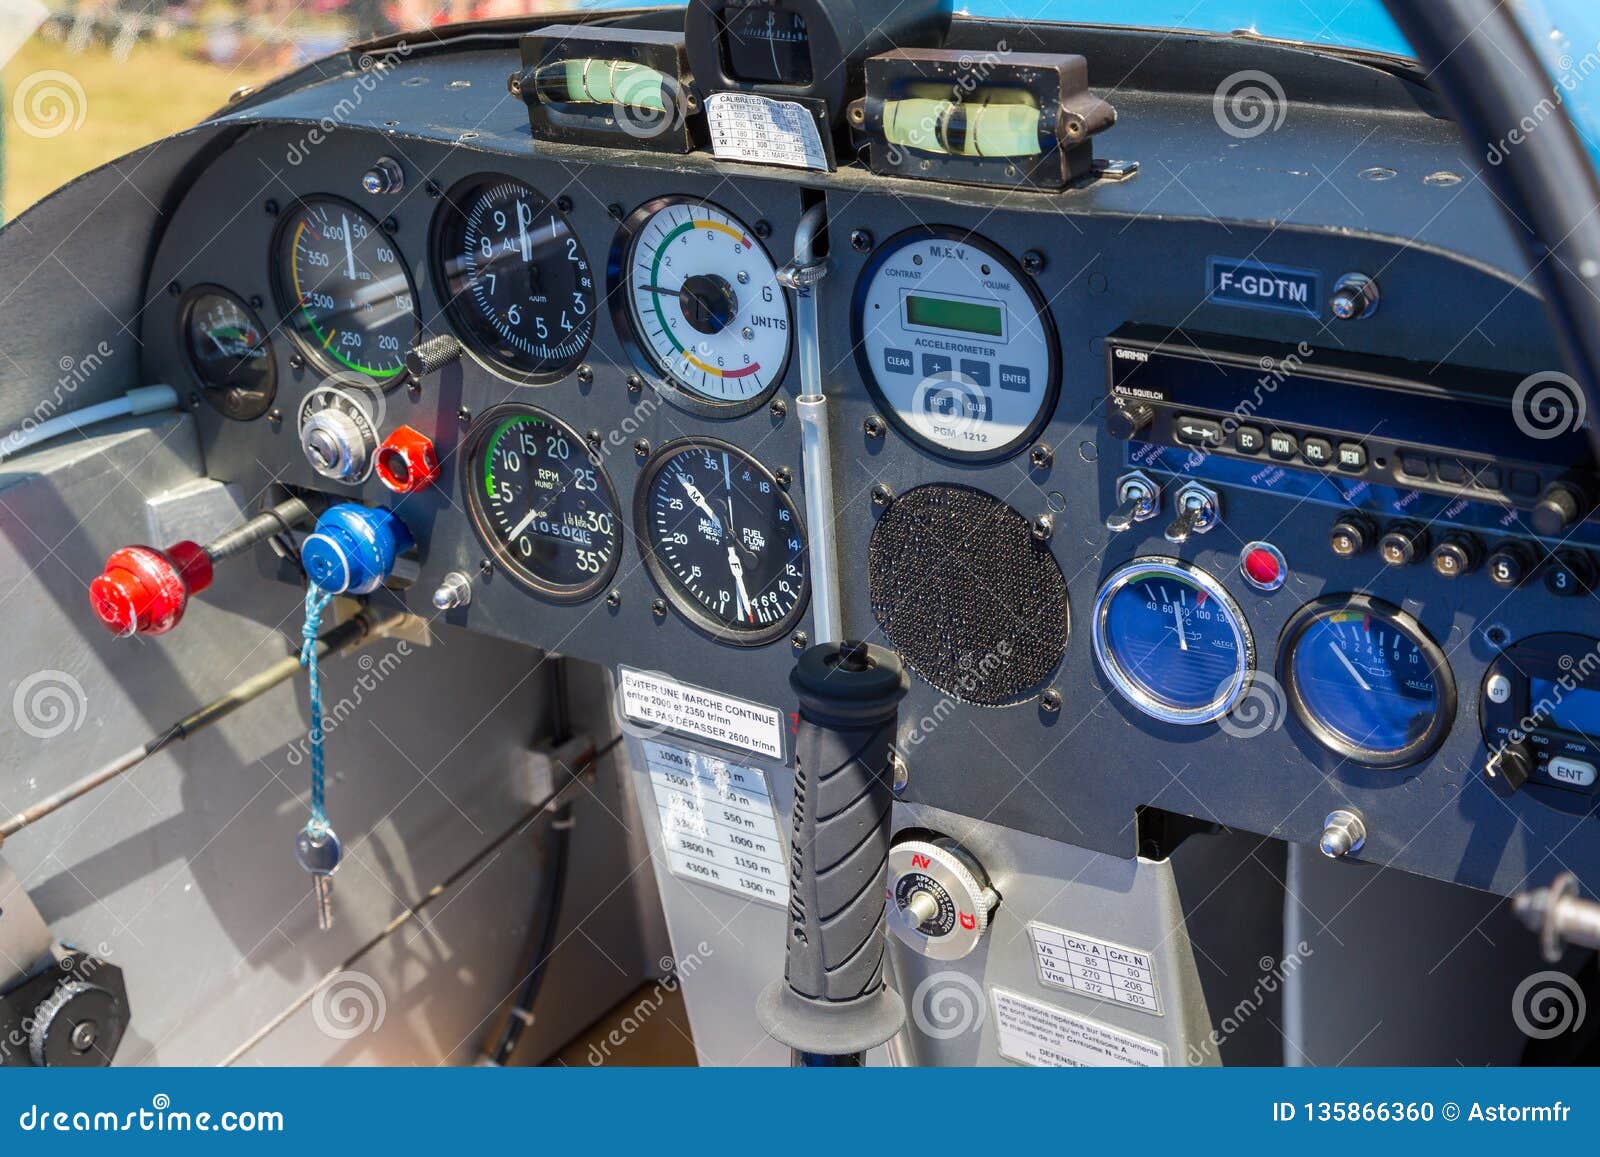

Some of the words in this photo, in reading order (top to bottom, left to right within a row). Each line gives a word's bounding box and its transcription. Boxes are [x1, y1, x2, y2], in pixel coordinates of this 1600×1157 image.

[494, 210, 506, 232] 9
[323, 227, 344, 240] 400
[352, 225, 367, 238] 50
[707, 231, 714, 241] 6
[481, 236, 492, 258] 8
[681, 236, 688, 245] 4
[377, 247, 394, 263] 100
[566, 237, 579, 261] 2
[734, 243, 741, 254] 8
[308, 251, 329, 266] 350
[664, 256, 672, 267] 2
[884, 267, 922, 280] CONTRAST
[485, 273, 496, 295] 7
[982, 279, 1011, 291] VOLUME
[1220, 272, 1308, 302] F-GDTM
[312, 292, 334, 309] 300
[763, 285, 773, 303] G
[573, 292, 586, 315] 3
[508, 304, 521, 325] 6
[561, 310, 574, 332] 4
[751, 314, 787, 330] UNITS
[536, 317, 548, 339] 5
[670, 317, 677, 328] 2
[341, 331, 361, 347] 250
[379, 335, 399, 350] 200
[914, 338, 996, 357] ACCELEROMETER
[717, 356, 725, 367] 6
[743, 354, 750, 364] 8
[1115, 349, 1149, 362] GARMIN
[887, 356, 911, 371] CLEAR
[1002, 373, 1027, 389] ENTER
[1133, 388, 1163, 400] SQUELCH
[519, 433, 537, 456] 15
[963, 431, 988, 446] 1212
[1241, 433, 1253, 449] EC
[546, 435, 569, 460] 20
[1271, 438, 1290, 455] MON
[1306, 444, 1324, 461] RCL
[501, 449, 520, 473] 10
[1340, 449, 1360, 466] MEM
[704, 460, 718, 471] 35
[538, 468, 559, 482] RPM
[574, 467, 598, 492] 25
[500, 481, 514, 503] 5
[759, 482, 770, 494] 18
[690, 491, 700, 502] M
[670, 498, 684, 511] 25
[586, 510, 611, 535] 30
[779, 510, 790, 521] 16
[672, 533, 688, 545] 20
[742, 527, 764, 540] FUEL
[520, 535, 532, 557] 0
[743, 535, 765, 548] FLOW
[789, 540, 801, 550] 14
[1341, 537, 1348, 548] 5
[1392, 546, 1399, 556] 5
[575, 549, 600, 573] 35
[1445, 556, 1452, 567] 5
[691, 565, 702, 578] 15
[785, 563, 796, 576] 12
[1499, 563, 1509, 578] 5
[779, 580, 790, 592] 10
[1556, 572, 1565, 588] 3
[719, 590, 730, 602] 10
[751, 598, 759, 608] 4
[762, 595, 769, 606] 6
[769, 592, 777, 603] 8
[1146, 602, 1157, 611] 40
[1162, 604, 1173, 614] 60
[1196, 609, 1211, 620] 100
[1354, 643, 1360, 652] 2
[1379, 648, 1385, 657] 6
[1394, 651, 1400, 660] 8
[1409, 654, 1418, 664] 10
[626, 690, 650, 703] entre
[651, 696, 672, 709] 2000
[673, 702, 683, 712] et
[684, 705, 706, 719] 2350
[707, 711, 732, 727] tr/mn
[660, 686, 680, 700] UNE
[682, 692, 723, 712] MARCHE
[725, 705, 776, 727] CONTINUE
[640, 706, 654, 718] NE
[655, 710, 674, 724] PAS
[728, 731, 750, 746] 2600
[752, 738, 777, 754] tr/mn
[659, 749, 684, 766] 1000
[664, 772, 688, 788] 1500
[1557, 764, 1584, 782] ENT
[739, 796, 750, 806] m
[723, 811, 743, 826] 550
[744, 819, 755, 829] m
[680, 840, 704, 854] 3800
[705, 847, 715, 858] ft
[729, 834, 753, 850] 1000
[755, 843, 766, 853] m
[734, 856, 759, 872] 1150
[760, 866, 771, 875] m
[912, 853, 931, 869] AV
[685, 862, 710, 877] 4300
[711, 869, 720, 880] ft
[739, 878, 763, 893] 1300
[765, 887, 776, 897] m
[1067, 940, 1089, 952] CAT.
[1092, 945, 1100, 955] A
[1040, 944, 1053, 955] Vs
[1085, 957, 1097, 967] 85
[1110, 950, 1132, 964] CAT.
[1134, 956, 1143, 966] N
[1042, 957, 1055, 968] Va
[1082, 968, 1100, 981] 270
[1124, 979, 1143, 992] 206
[1044, 970, 1065, 983] Vne
[1085, 981, 1102, 994] 372
[1127, 993, 1144, 1006] 303
[1113, 1034, 1160, 1057] instruments
